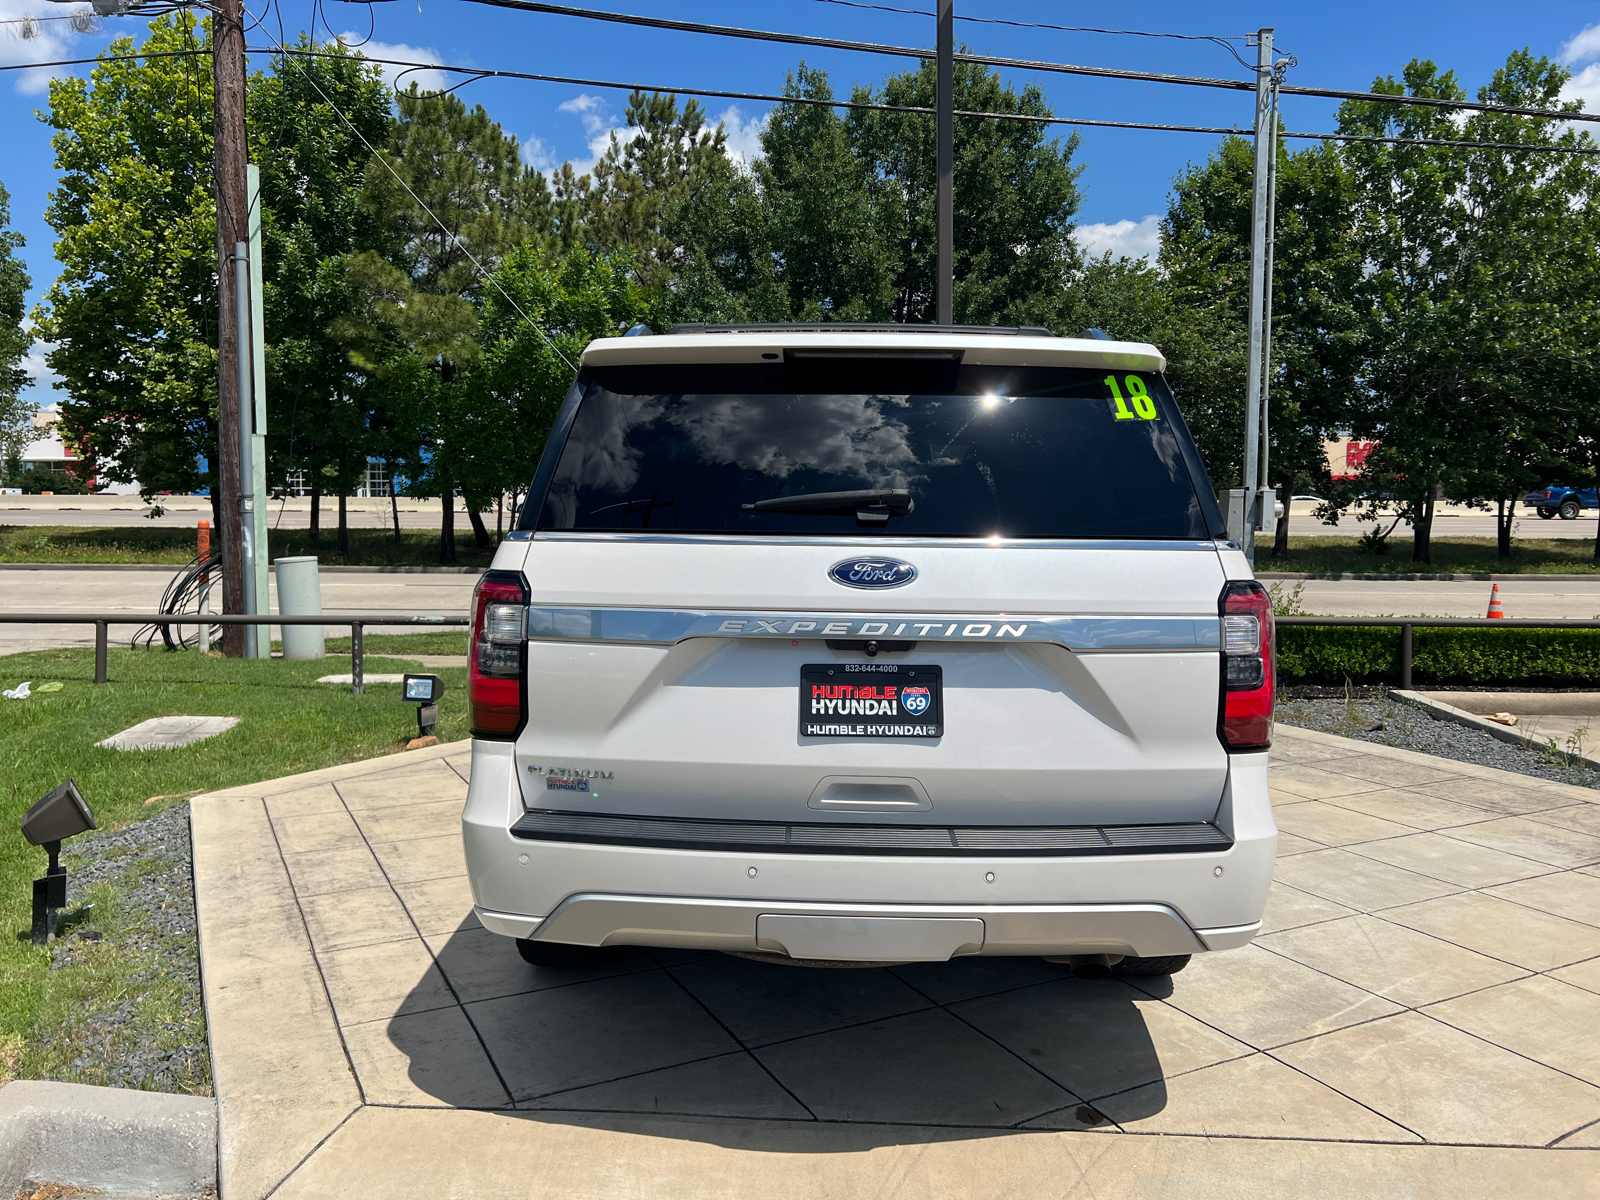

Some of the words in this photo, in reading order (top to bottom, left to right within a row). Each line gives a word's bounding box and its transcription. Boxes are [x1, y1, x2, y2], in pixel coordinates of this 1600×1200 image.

[1104, 374, 1157, 420] 18
[850, 562, 896, 581] Ford
[717, 619, 1028, 637] EXPEDITION
[845, 665, 898, 673] 832-644-4000
[811, 699, 897, 716] HYUNDAI
[906, 697, 926, 710] 69
[867, 725, 927, 736] HYUNDAI
[527, 765, 614, 779] PLATINUM
